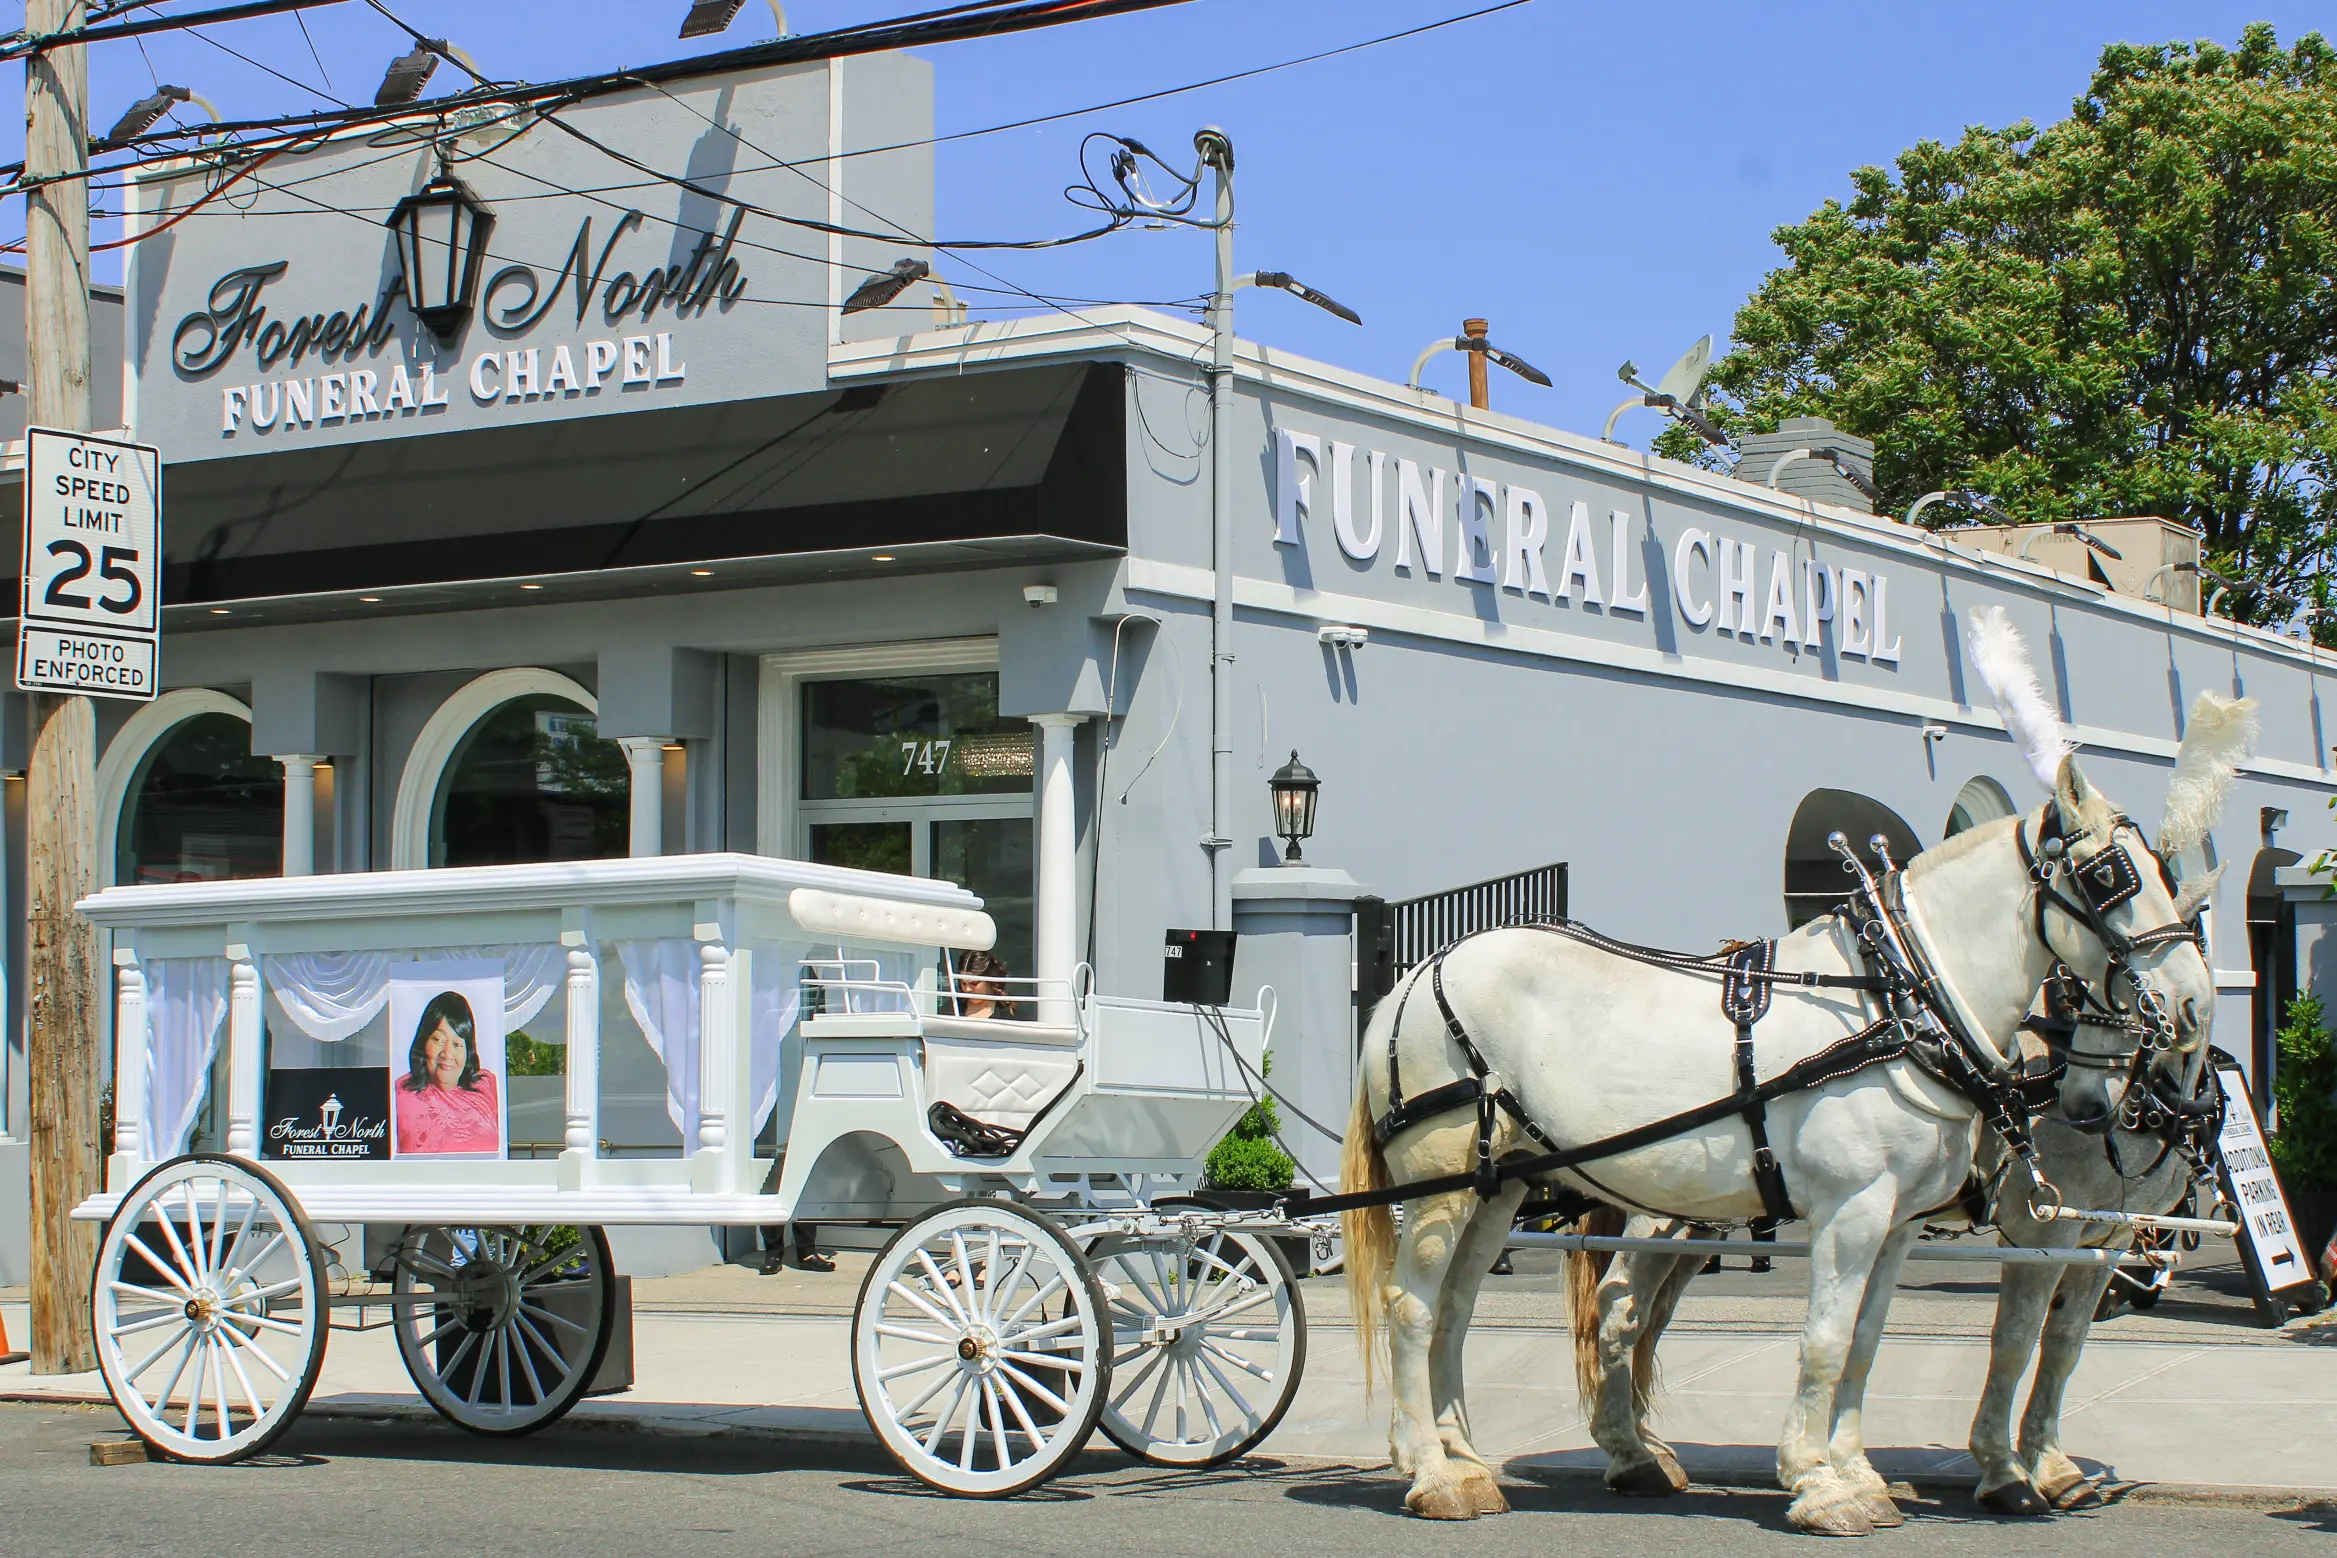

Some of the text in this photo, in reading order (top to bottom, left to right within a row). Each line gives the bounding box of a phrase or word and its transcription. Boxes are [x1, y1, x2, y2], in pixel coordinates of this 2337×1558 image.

[173, 207, 747, 373] Forest North
[222, 333, 686, 433] FUNERAL CHAPEL
[69, 447, 119, 474] CITY
[56, 475, 130, 505] SPEED
[64, 506, 123, 533] LIMIT
[1272, 427, 1901, 663] FUNERAL CHAPEL
[44, 539, 142, 614] 25
[59, 639, 125, 663] PHOTO
[34, 659, 143, 686] ENFORCED
[902, 741, 950, 775] 747
[1166, 946, 1182, 957] 747
[270, 1116, 387, 1139] Forest North
[283, 1143, 370, 1155] FUNERAL CHAPEL
[2223, 1145, 2270, 1174] ADDITIONAL
[2240, 1178, 2278, 1206] PARKING
[2253, 1210, 2288, 1239] IN REAR
